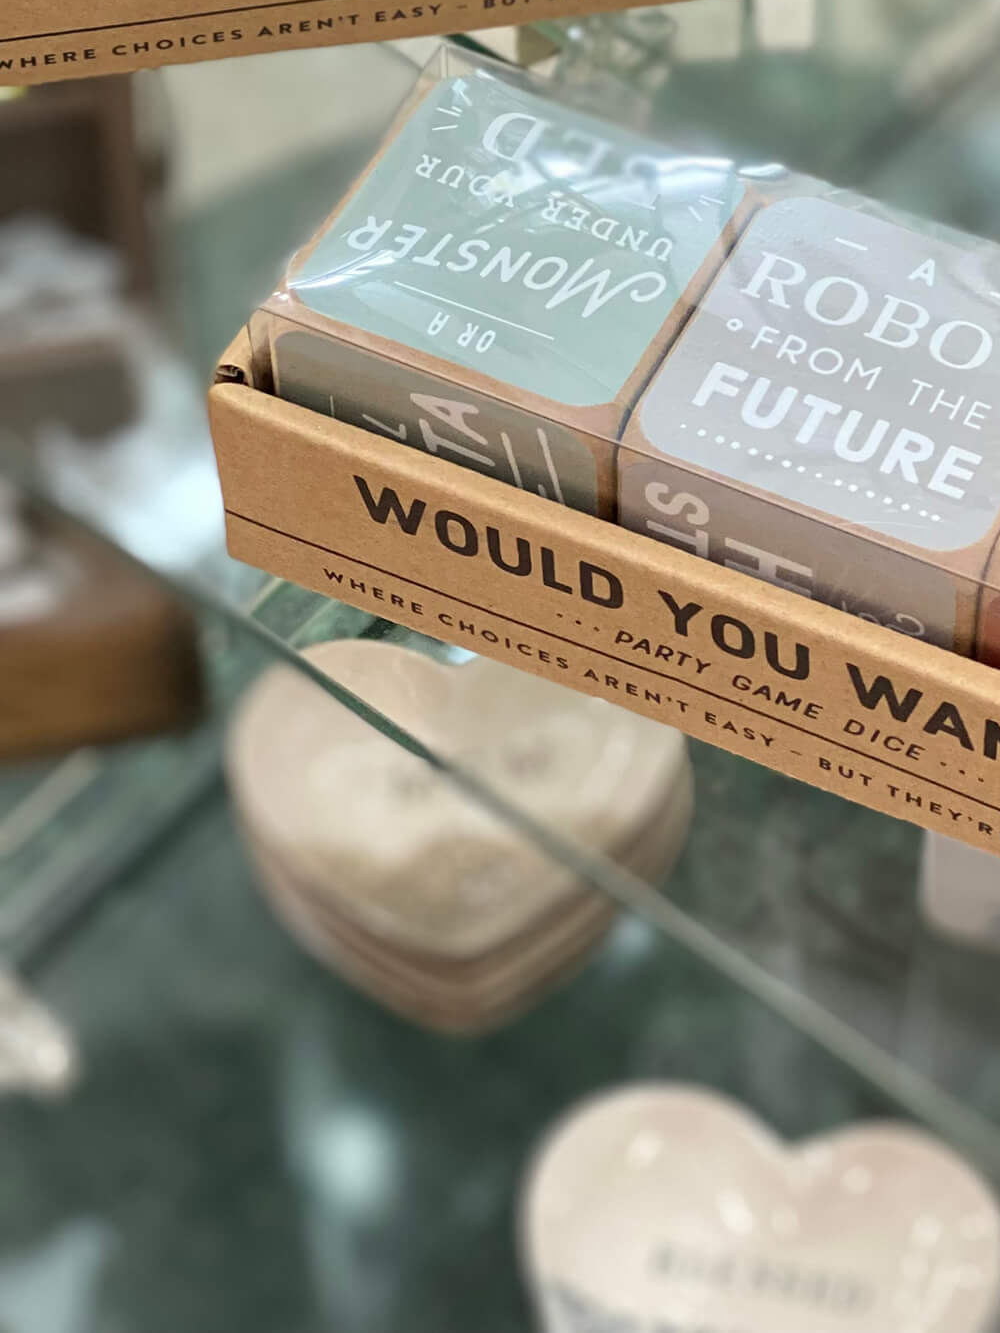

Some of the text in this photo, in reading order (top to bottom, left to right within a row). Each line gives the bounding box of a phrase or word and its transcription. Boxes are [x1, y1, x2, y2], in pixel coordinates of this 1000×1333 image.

[111, 28, 244, 57] CHOICES
[258, 14, 360, 38] AREN'T
[374, 4, 443, 24] EASY
[346, 215, 667, 319] MONSTER
[540, 191, 674, 264] UNDER
[907, 258, 937, 287] A
[456, 320, 498, 354] OR
[750, 325, 993, 431] FROM THE
[691, 361, 984, 501] FUTURE
[351, 474, 625, 610] WOULD
[658, 589, 810, 681] YOU
[322, 567, 426, 616] WHERE
[438, 613, 571, 670] CHOICES
[583, 668, 689, 714] AREN'T
[704, 712, 777, 747] EASY
[818, 757, 873, 787] BUT
[614, 629, 926, 762] PARTY GAME DICE
